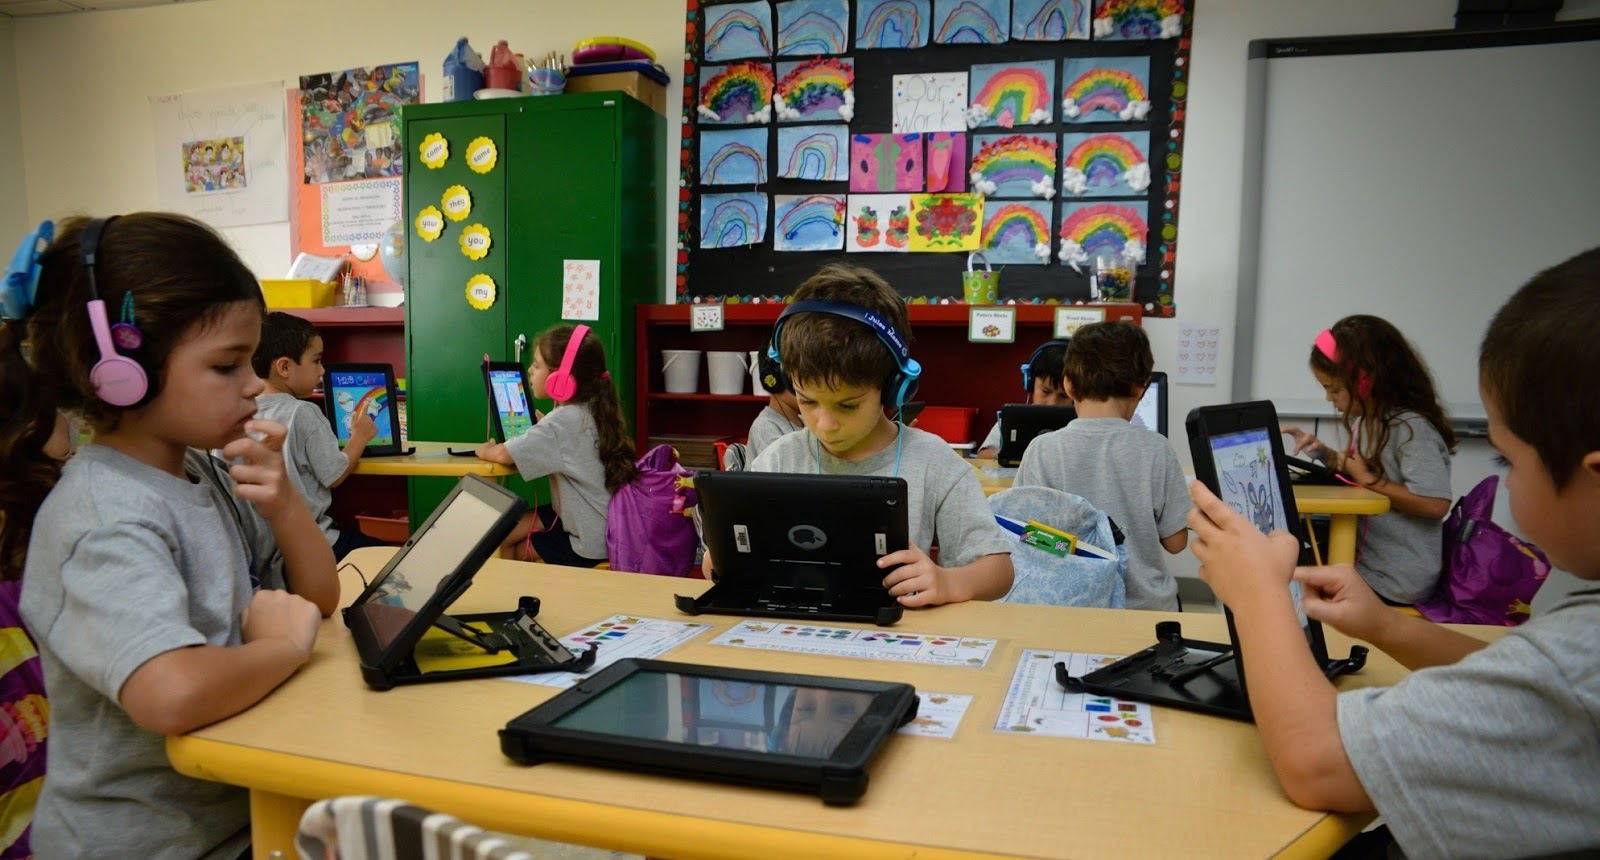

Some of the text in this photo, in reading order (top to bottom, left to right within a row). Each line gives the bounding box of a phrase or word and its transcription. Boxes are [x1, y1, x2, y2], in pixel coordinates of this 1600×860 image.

[907, 74, 951, 102] Our
[895, 99, 949, 133] Work
[426, 143, 444, 159] come
[473, 147, 492, 163] some
[449, 198, 466, 209] they
[422, 220, 438, 229] your
[468, 236, 484, 246] you
[475, 287, 488, 298] my
[868, 314, 886, 330] Jules
